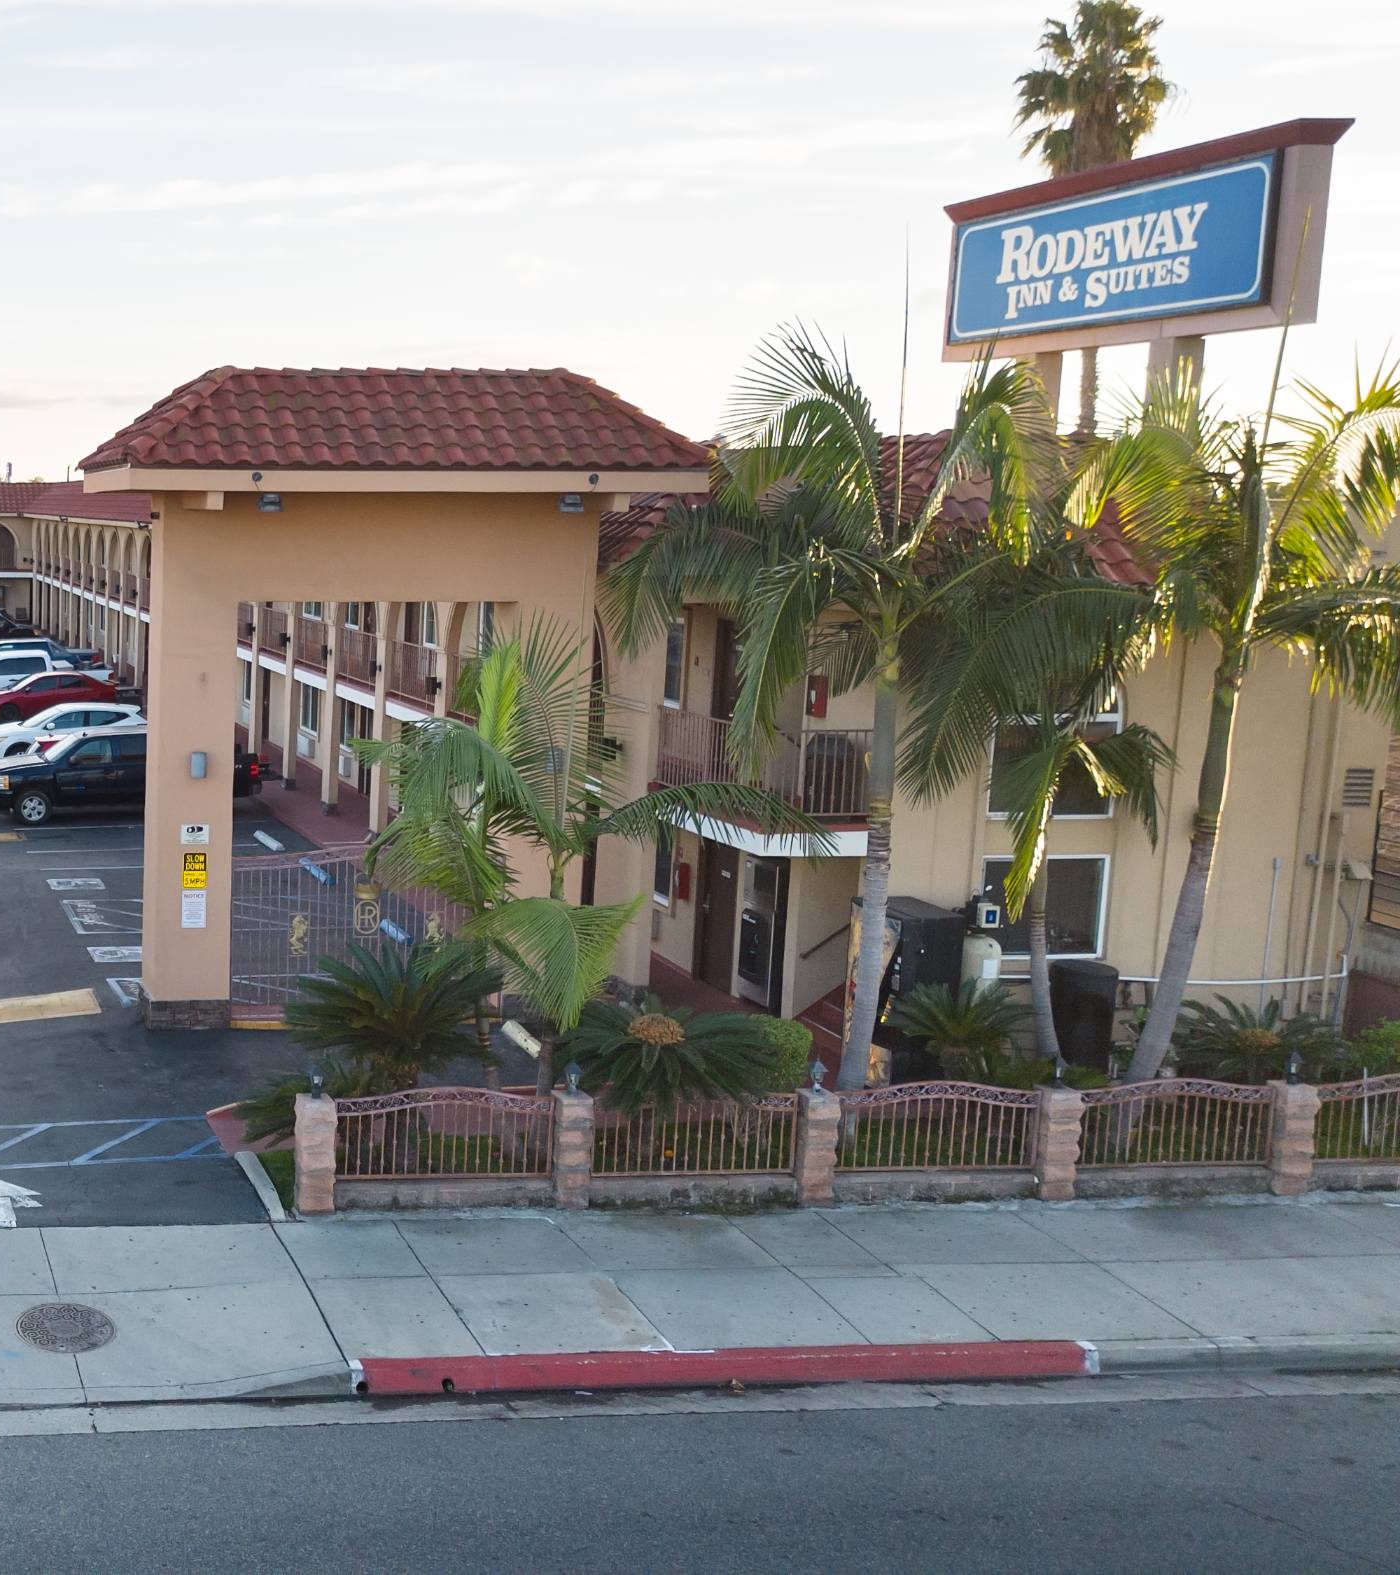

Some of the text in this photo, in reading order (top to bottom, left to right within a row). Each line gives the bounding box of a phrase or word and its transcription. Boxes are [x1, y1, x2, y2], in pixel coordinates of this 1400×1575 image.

[996, 202, 1208, 284] RODEWAY
[1004, 256, 1191, 320] INN & SUITES
[185, 863, 205, 871] DOWN
[186, 855, 205, 863] SLOW
